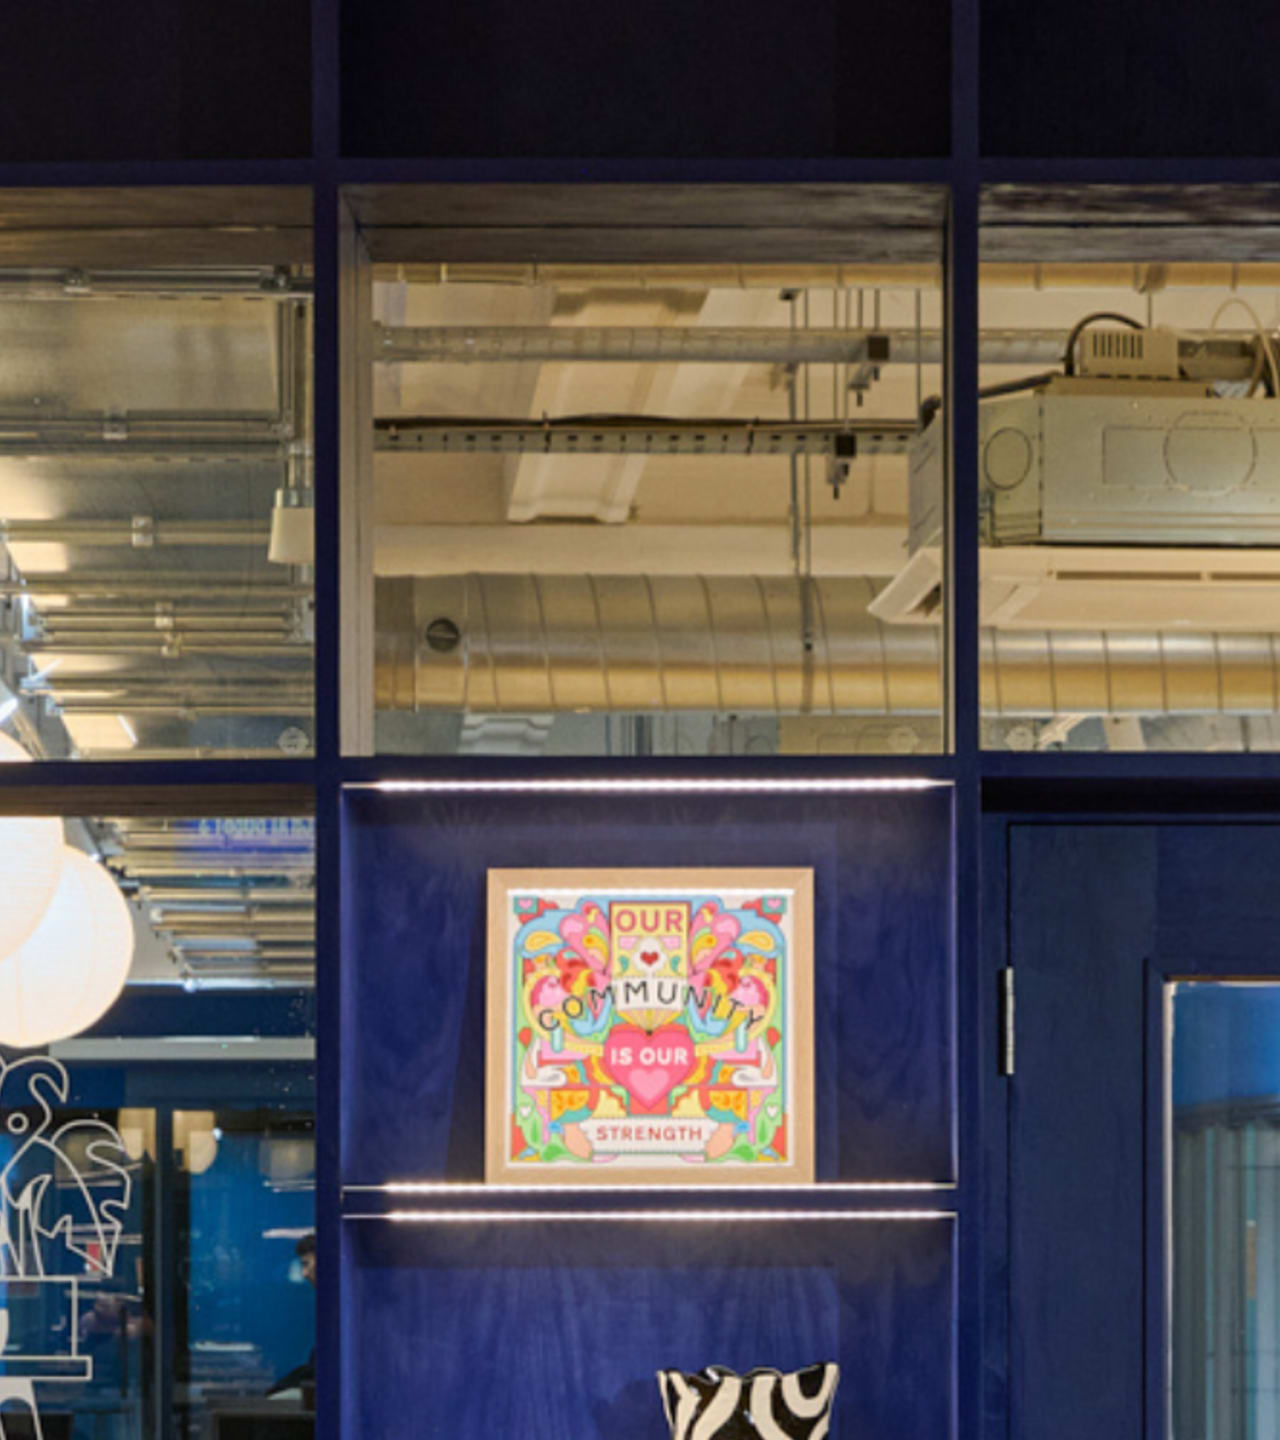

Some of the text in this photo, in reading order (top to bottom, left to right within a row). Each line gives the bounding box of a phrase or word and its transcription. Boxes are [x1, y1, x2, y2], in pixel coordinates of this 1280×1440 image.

[615, 909, 683, 933] OUR
[538, 981, 764, 1032] COMMUNITY
[611, 1048, 688, 1065] IS OUR
[596, 1127, 703, 1142] STRENGTH
